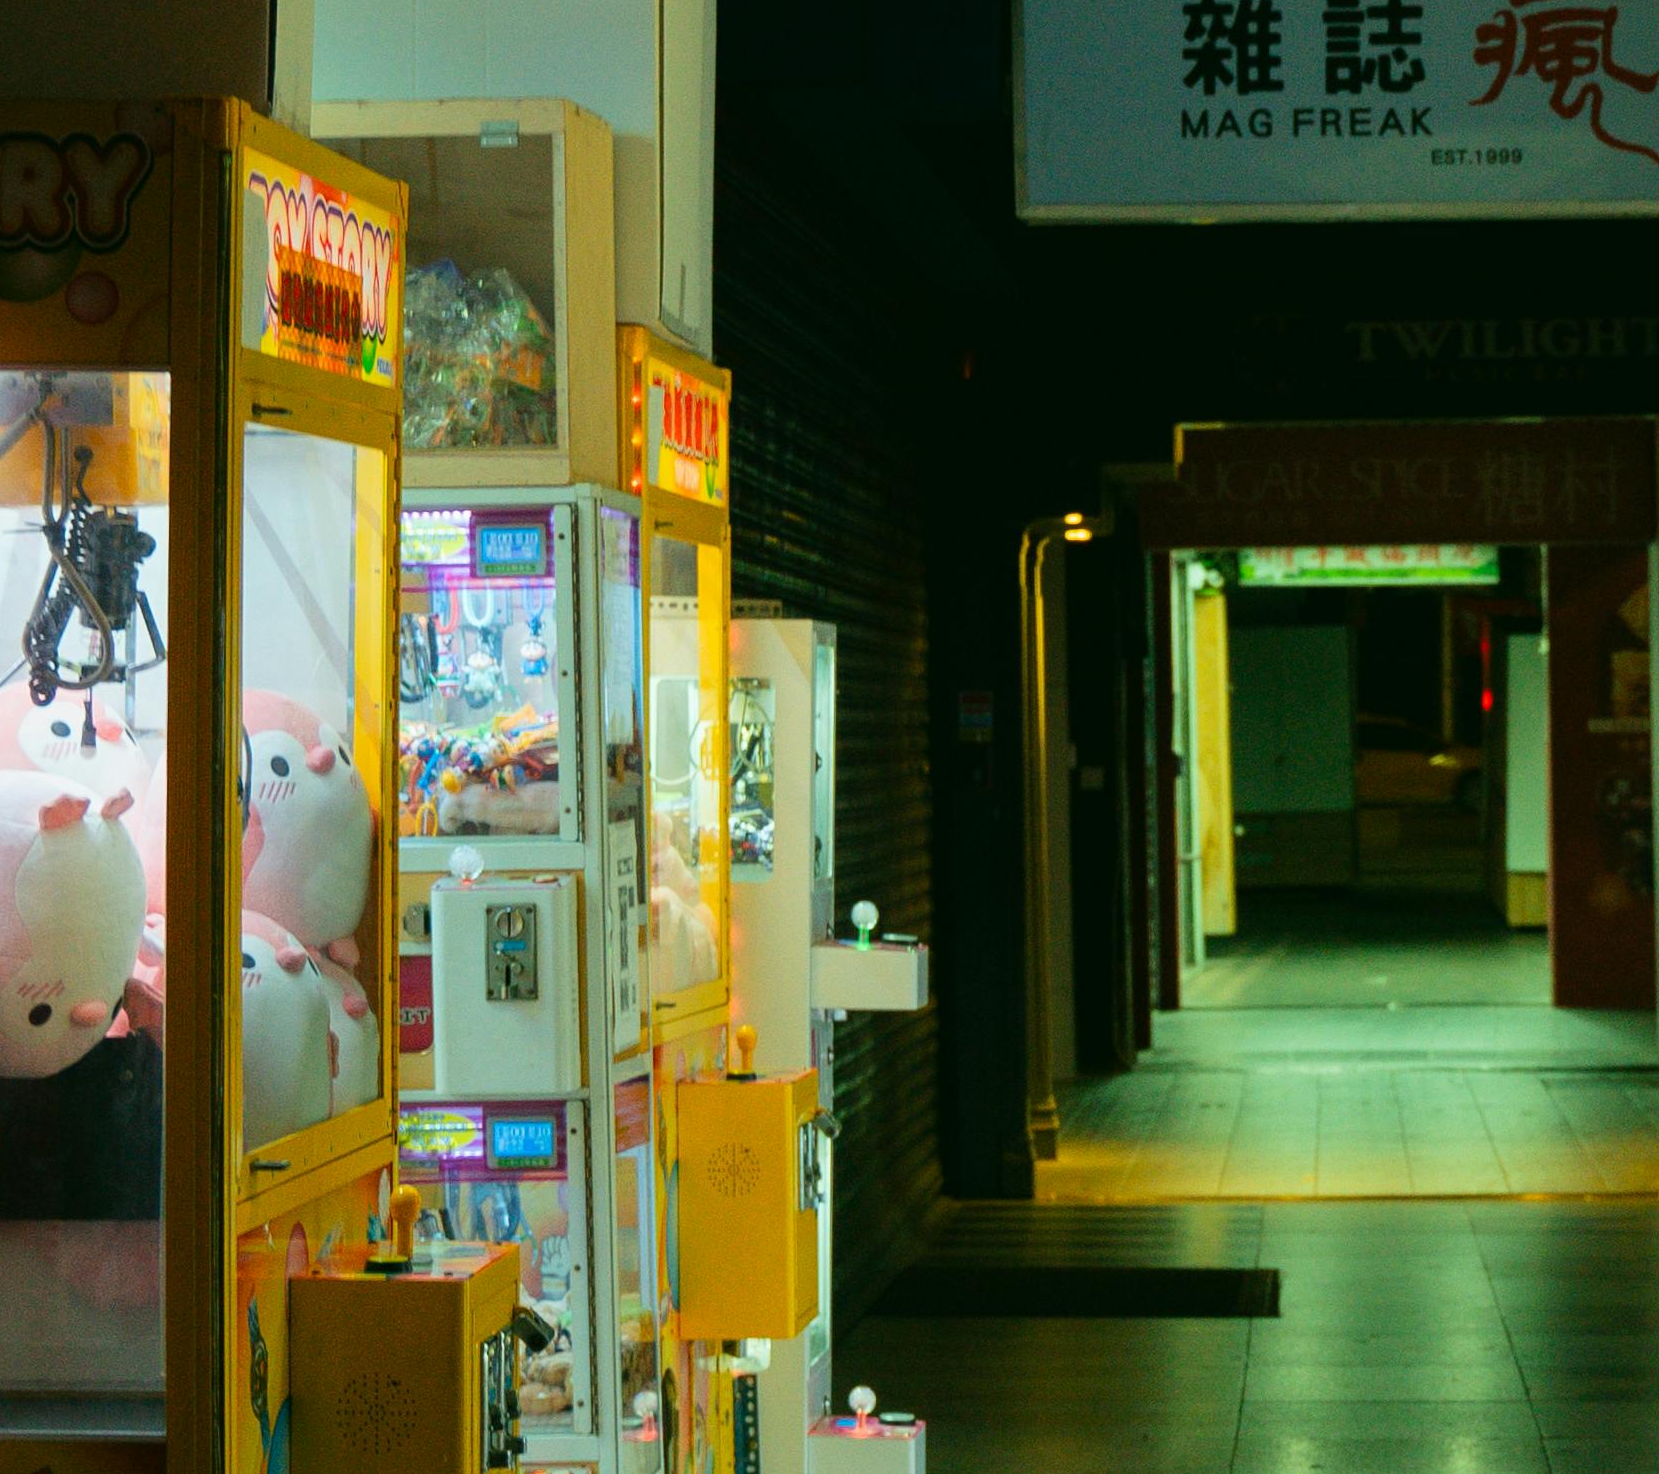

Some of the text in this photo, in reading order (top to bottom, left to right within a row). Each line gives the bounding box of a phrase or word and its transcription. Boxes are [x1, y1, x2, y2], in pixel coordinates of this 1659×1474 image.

[1181, 107, 1433, 138] MAG FREAK
[1431, 147, 1523, 166] EST.1999
[1476, 447, 1626, 527] 糖村
